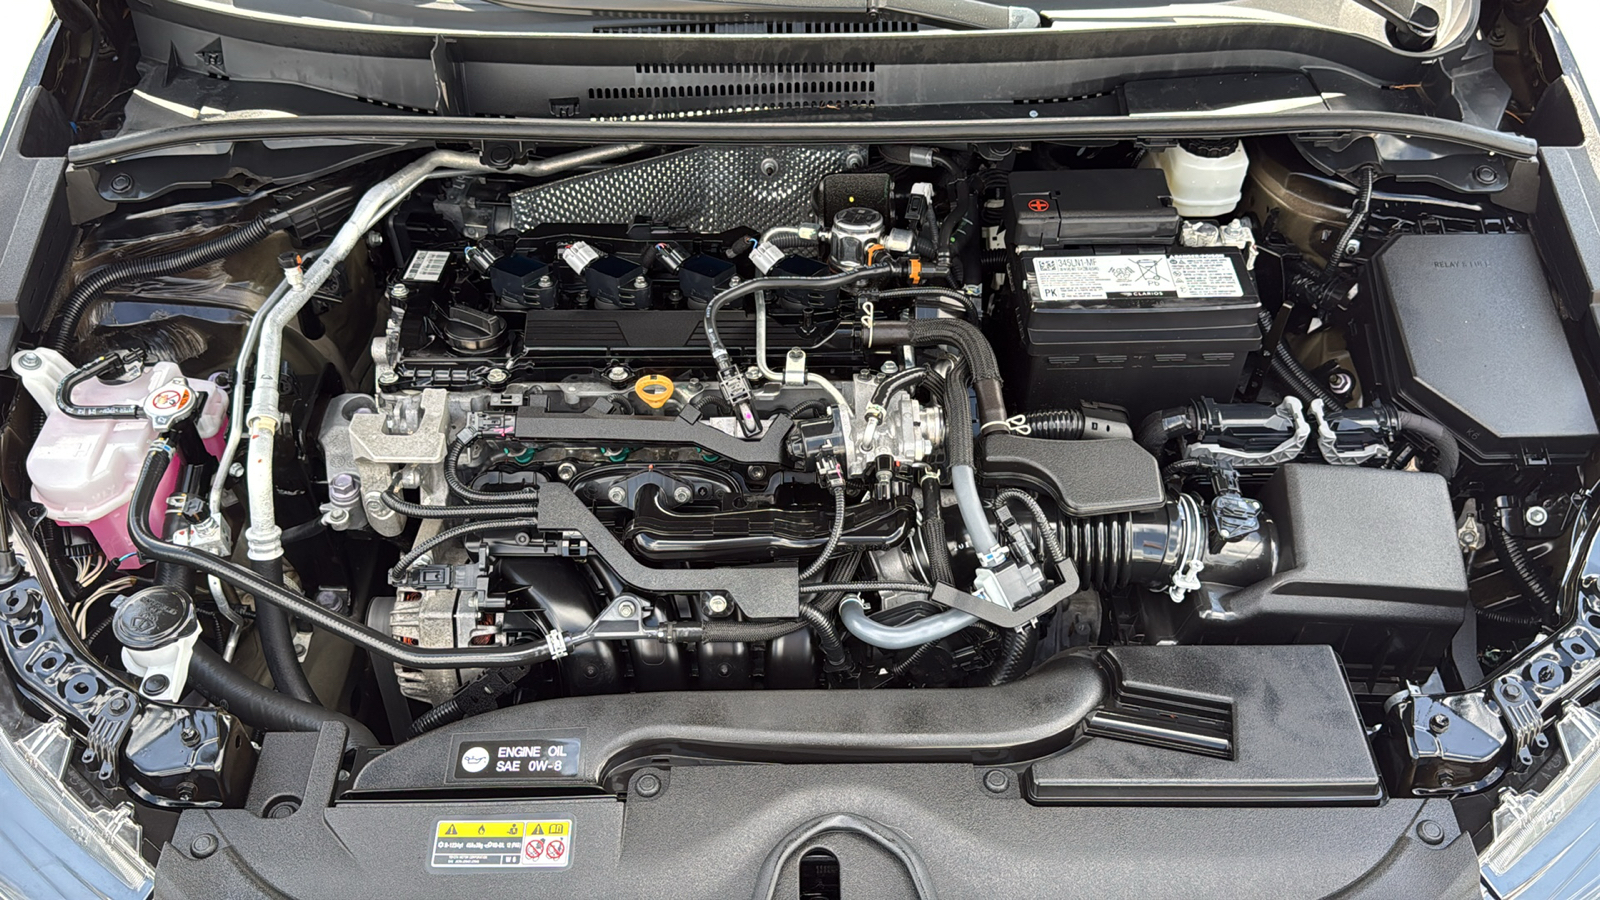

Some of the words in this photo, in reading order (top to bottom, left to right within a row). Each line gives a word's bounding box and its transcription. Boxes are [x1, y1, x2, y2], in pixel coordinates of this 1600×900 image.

[1058, 258, 1097, 266] 345LN1-MF
[1434, 260, 1459, 268] RELAY
[1044, 288, 1058, 297] PK
[1466, 428, 1481, 440] K6
[497, 746, 541, 758] ENGINE
[548, 745, 567, 757] OIL
[496, 761, 520, 772] SAE
[528, 760, 562, 771] 0W-8
